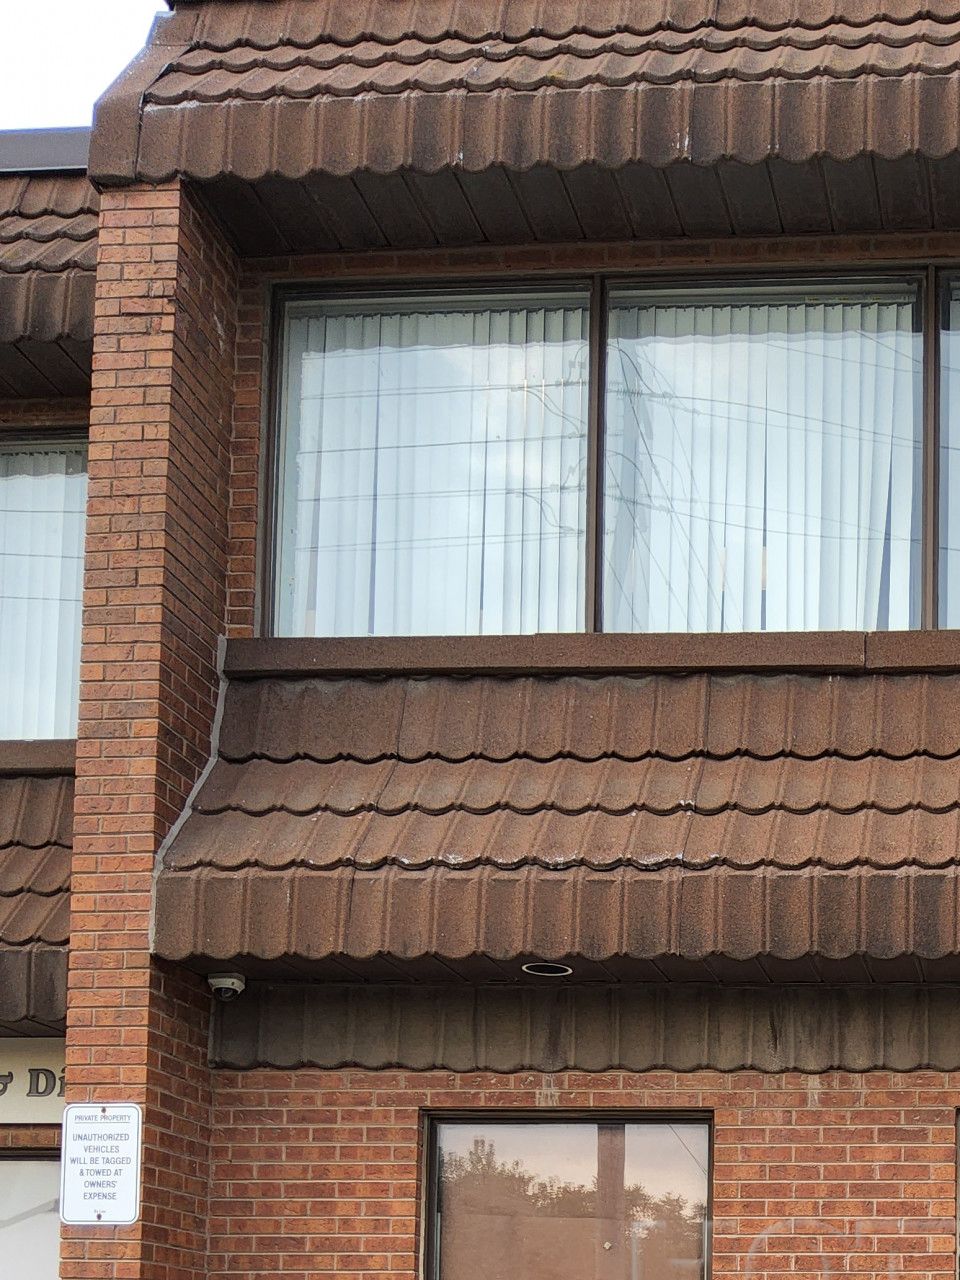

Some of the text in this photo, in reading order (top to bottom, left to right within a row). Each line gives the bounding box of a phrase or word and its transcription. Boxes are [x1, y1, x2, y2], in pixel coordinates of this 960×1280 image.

[72, 1133, 130, 1141] UNAUTHORIZED
[83, 1145, 120, 1153] VEHICLES
[69, 1156, 132, 1165] WILL BE TAGGED
[79, 1168, 123, 1176] & TOWED AT
[83, 1192, 117, 1200] EXPENSE
